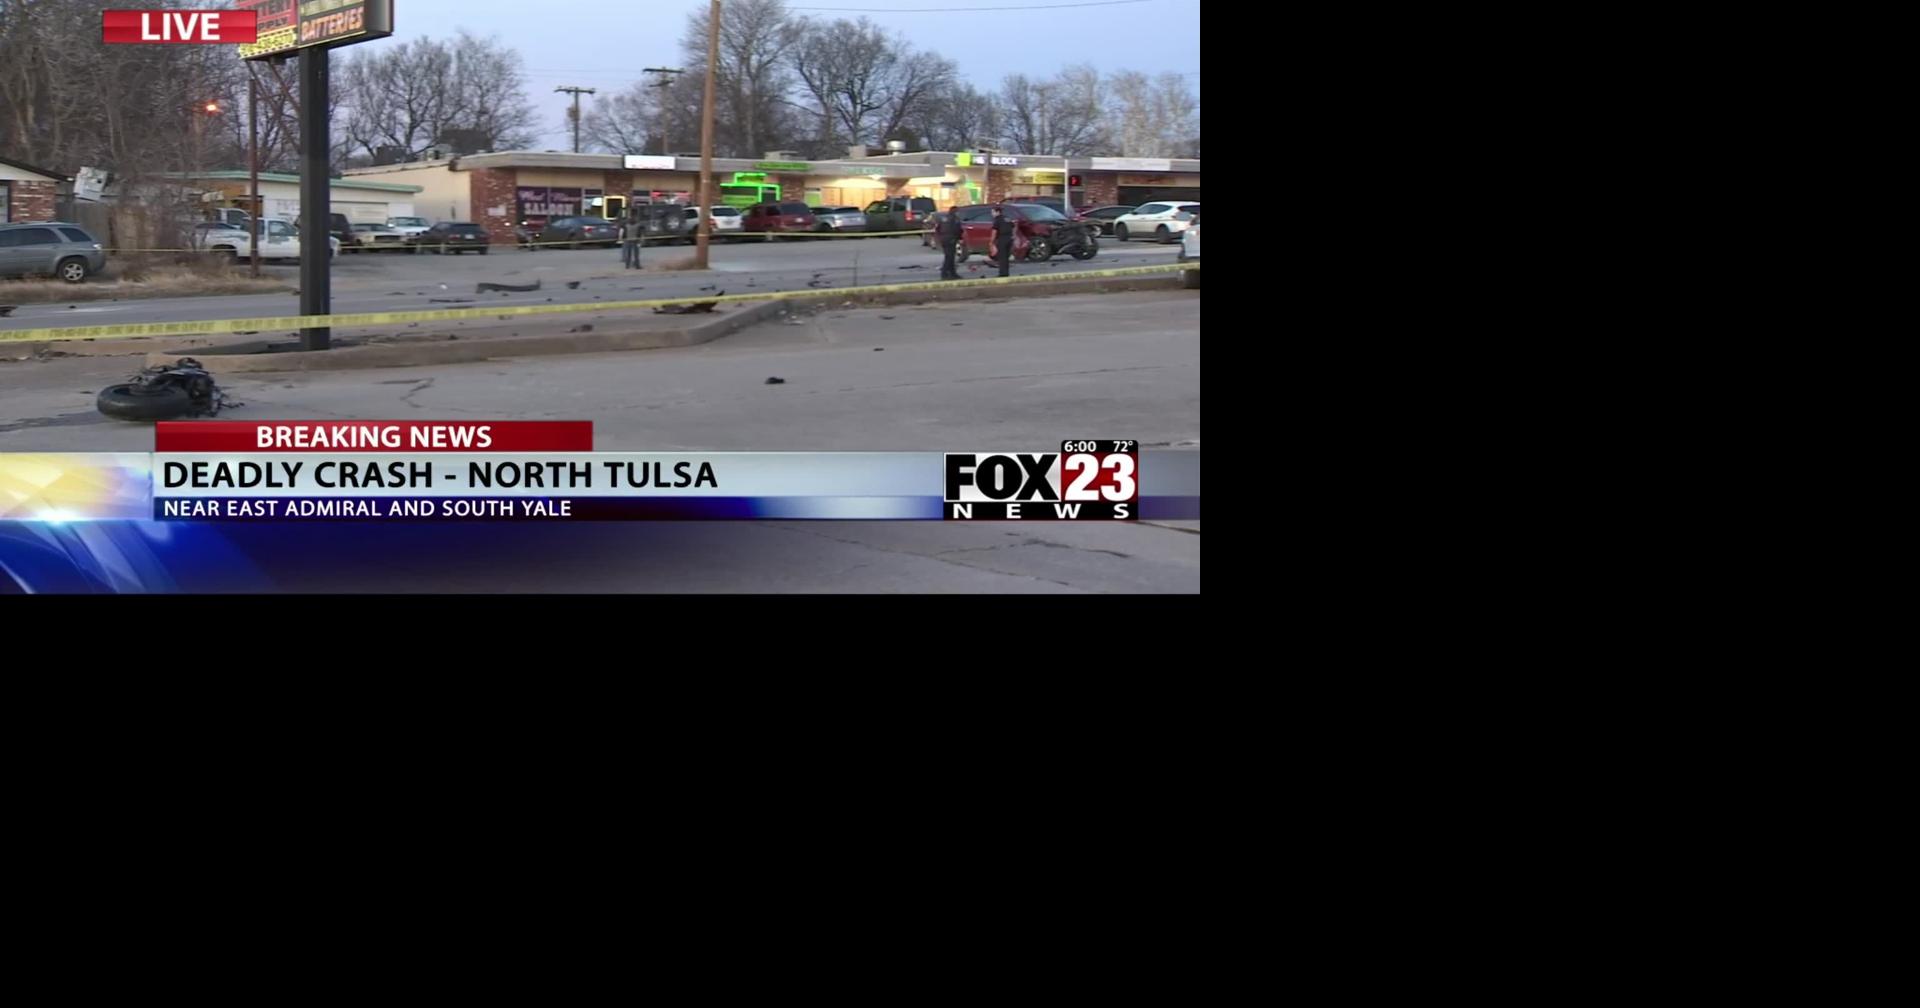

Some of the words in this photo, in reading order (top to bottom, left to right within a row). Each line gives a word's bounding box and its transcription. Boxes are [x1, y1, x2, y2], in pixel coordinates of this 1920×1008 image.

[301, 6, 364, 41] BATTERIES
[991, 156, 1018, 166] BLOCK
[524, 202, 574, 216] SALOON
